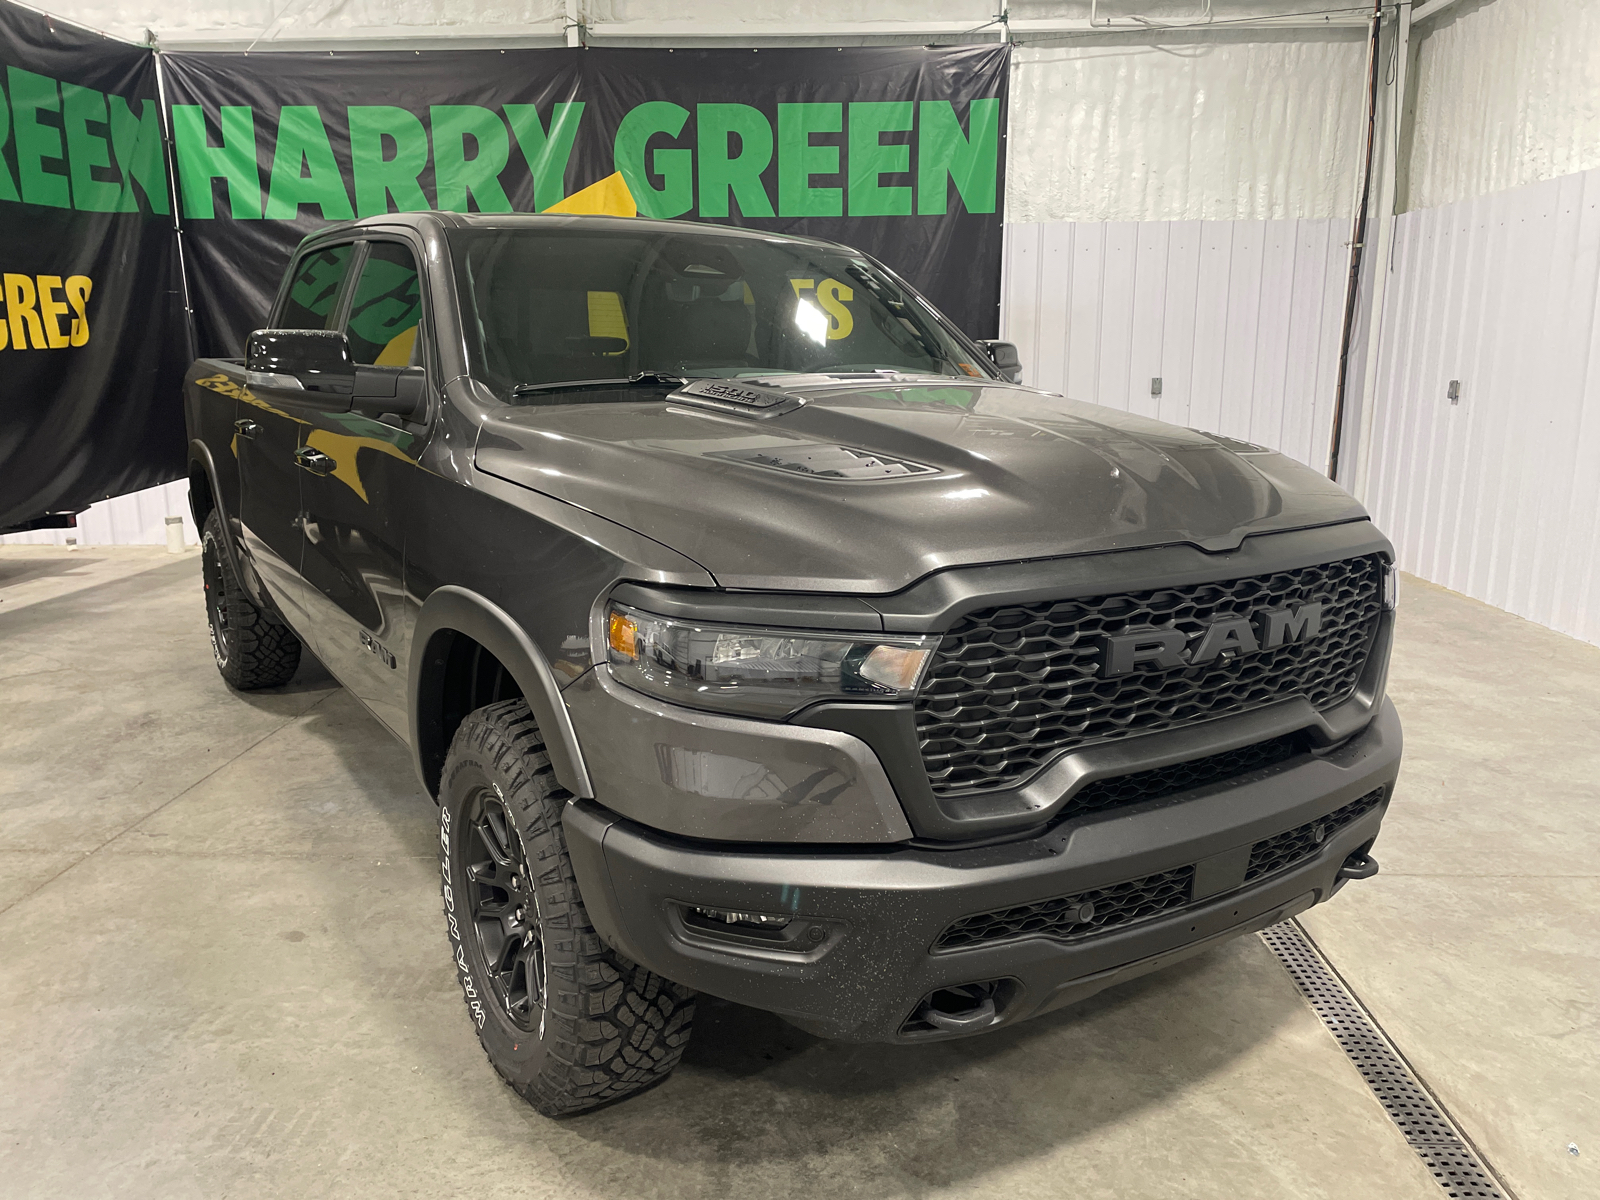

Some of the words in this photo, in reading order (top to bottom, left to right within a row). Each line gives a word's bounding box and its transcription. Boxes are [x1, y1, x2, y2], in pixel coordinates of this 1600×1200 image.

[0, 65, 170, 216] EEN
[172, 102, 586, 220] HARRY
[613, 98, 1000, 219] GREEN
[0, 272, 93, 350] RES
[1101, 602, 1322, 677] RAM
[440, 805, 486, 1030] WRANGLER
